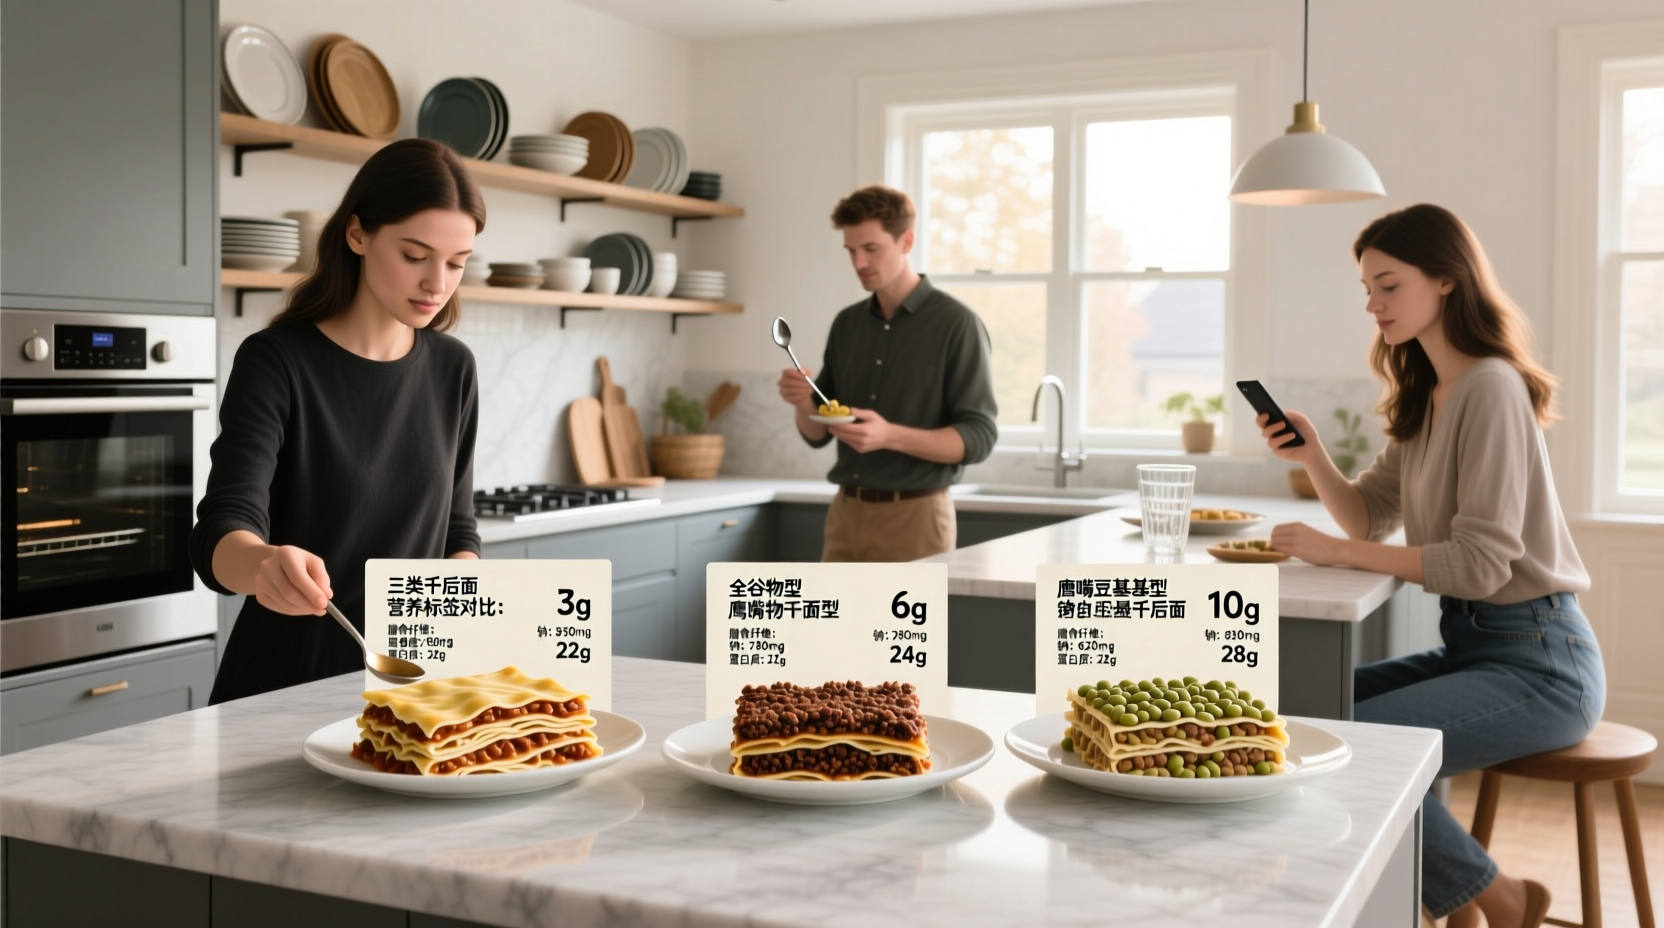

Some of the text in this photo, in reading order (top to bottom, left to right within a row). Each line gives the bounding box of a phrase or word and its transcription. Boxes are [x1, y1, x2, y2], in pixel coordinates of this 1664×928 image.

[387, 575, 479, 596] 三类千后面
[728, 577, 802, 599] 全谷物型
[556, 588, 591, 622] 3g
[891, 590, 928, 626] 6g
[1207, 590, 1260, 626] 10g
[555, 641, 591, 664] 22g
[889, 644, 927, 668] 24g
[1221, 644, 1259, 668] 28g
